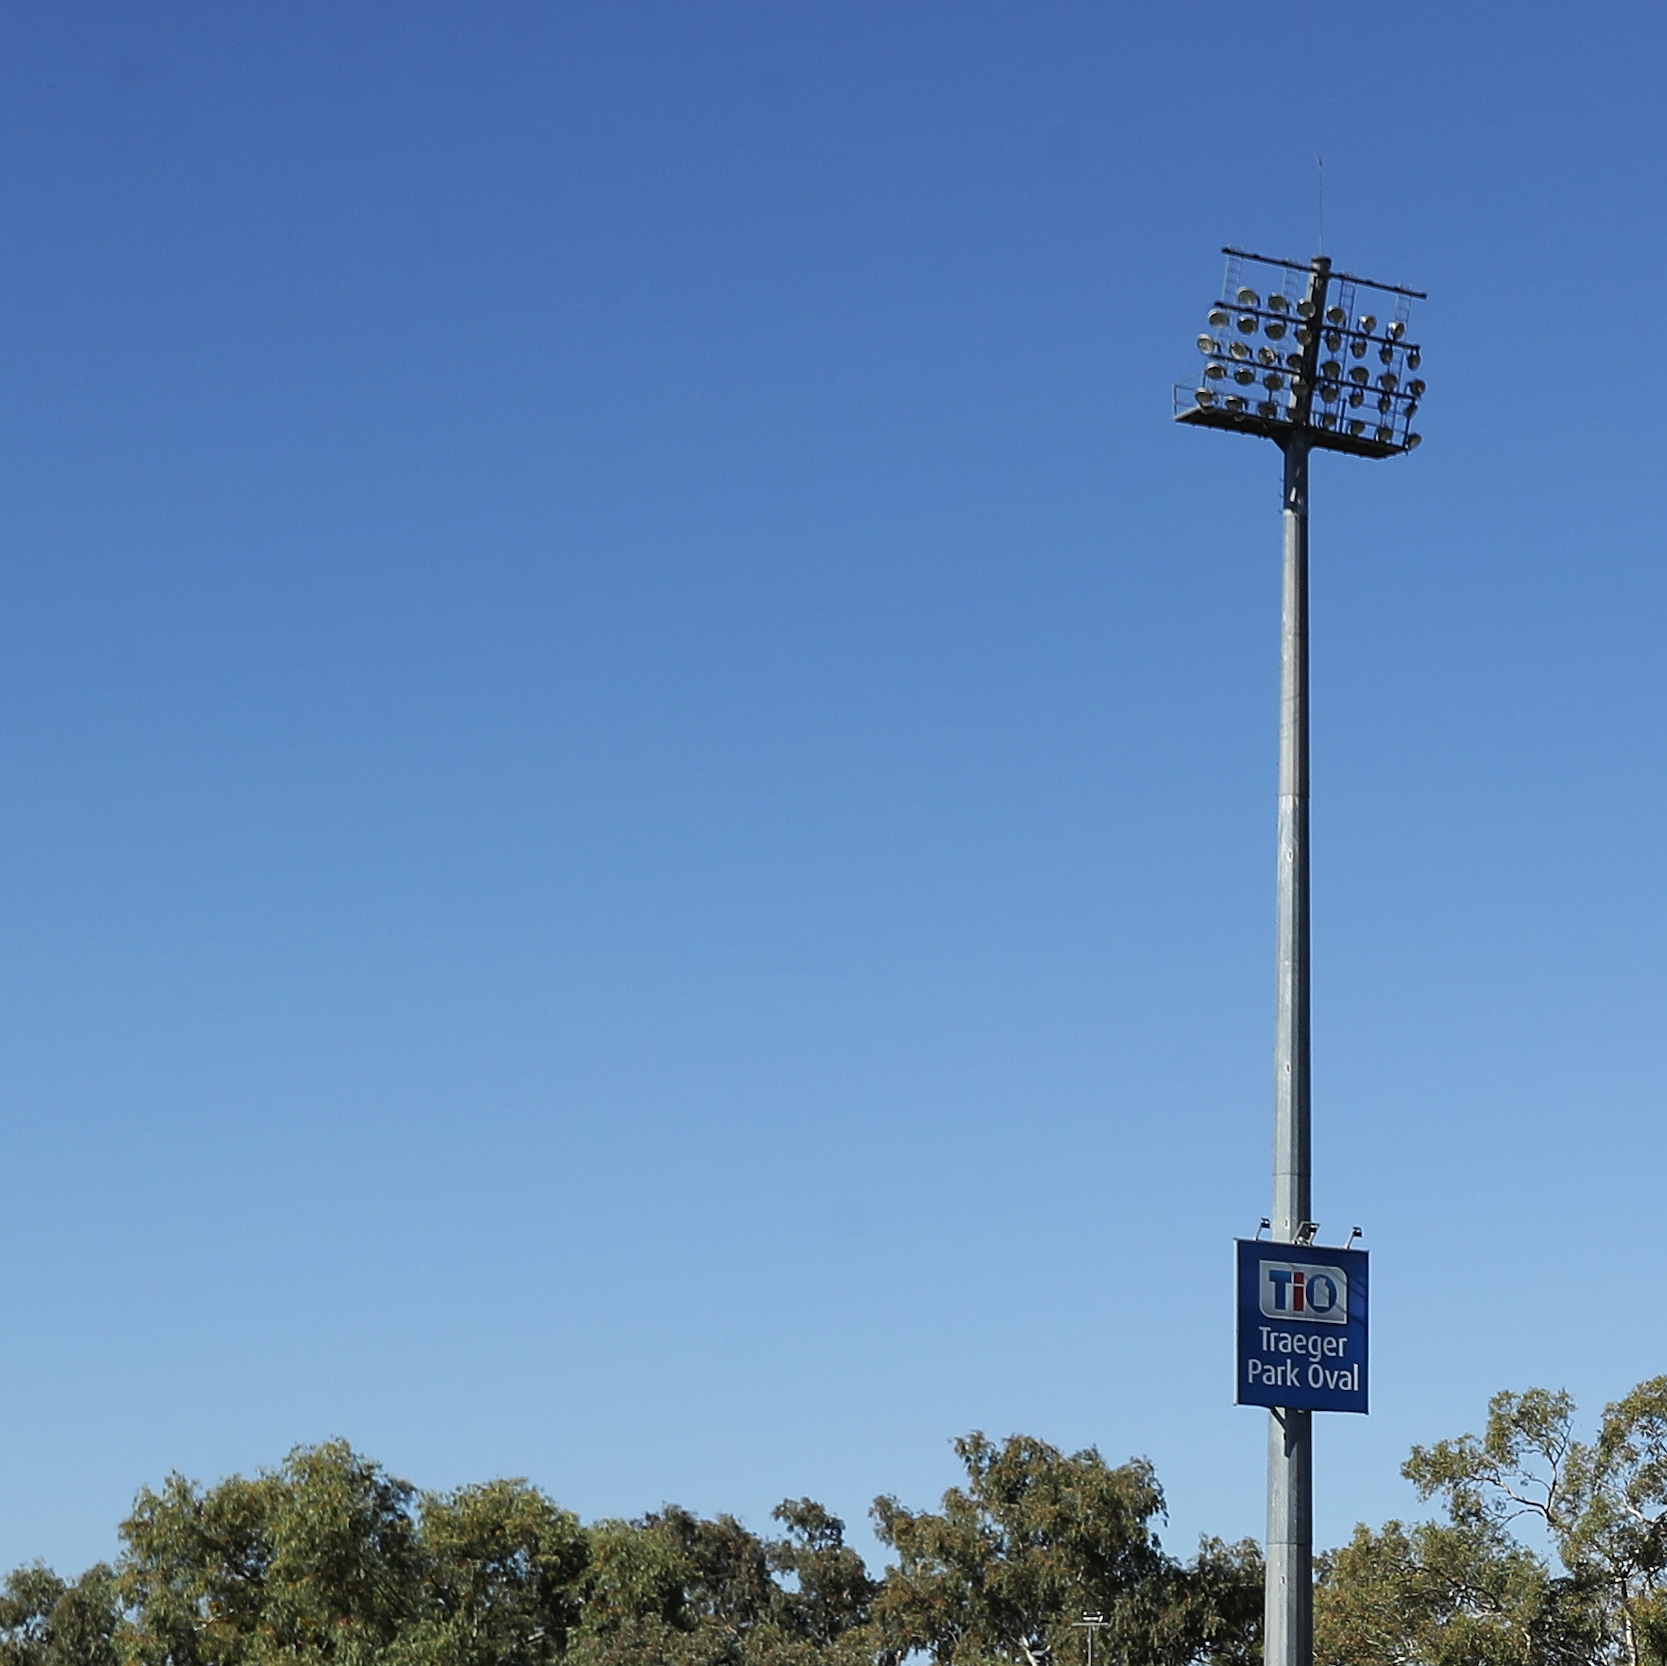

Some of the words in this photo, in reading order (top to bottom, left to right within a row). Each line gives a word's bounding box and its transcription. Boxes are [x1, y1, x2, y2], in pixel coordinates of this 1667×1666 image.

[1259, 1326, 1347, 1362] Traeger
[1248, 1359, 1300, 1387] Park
[1308, 1363, 1359, 1391] Oval
